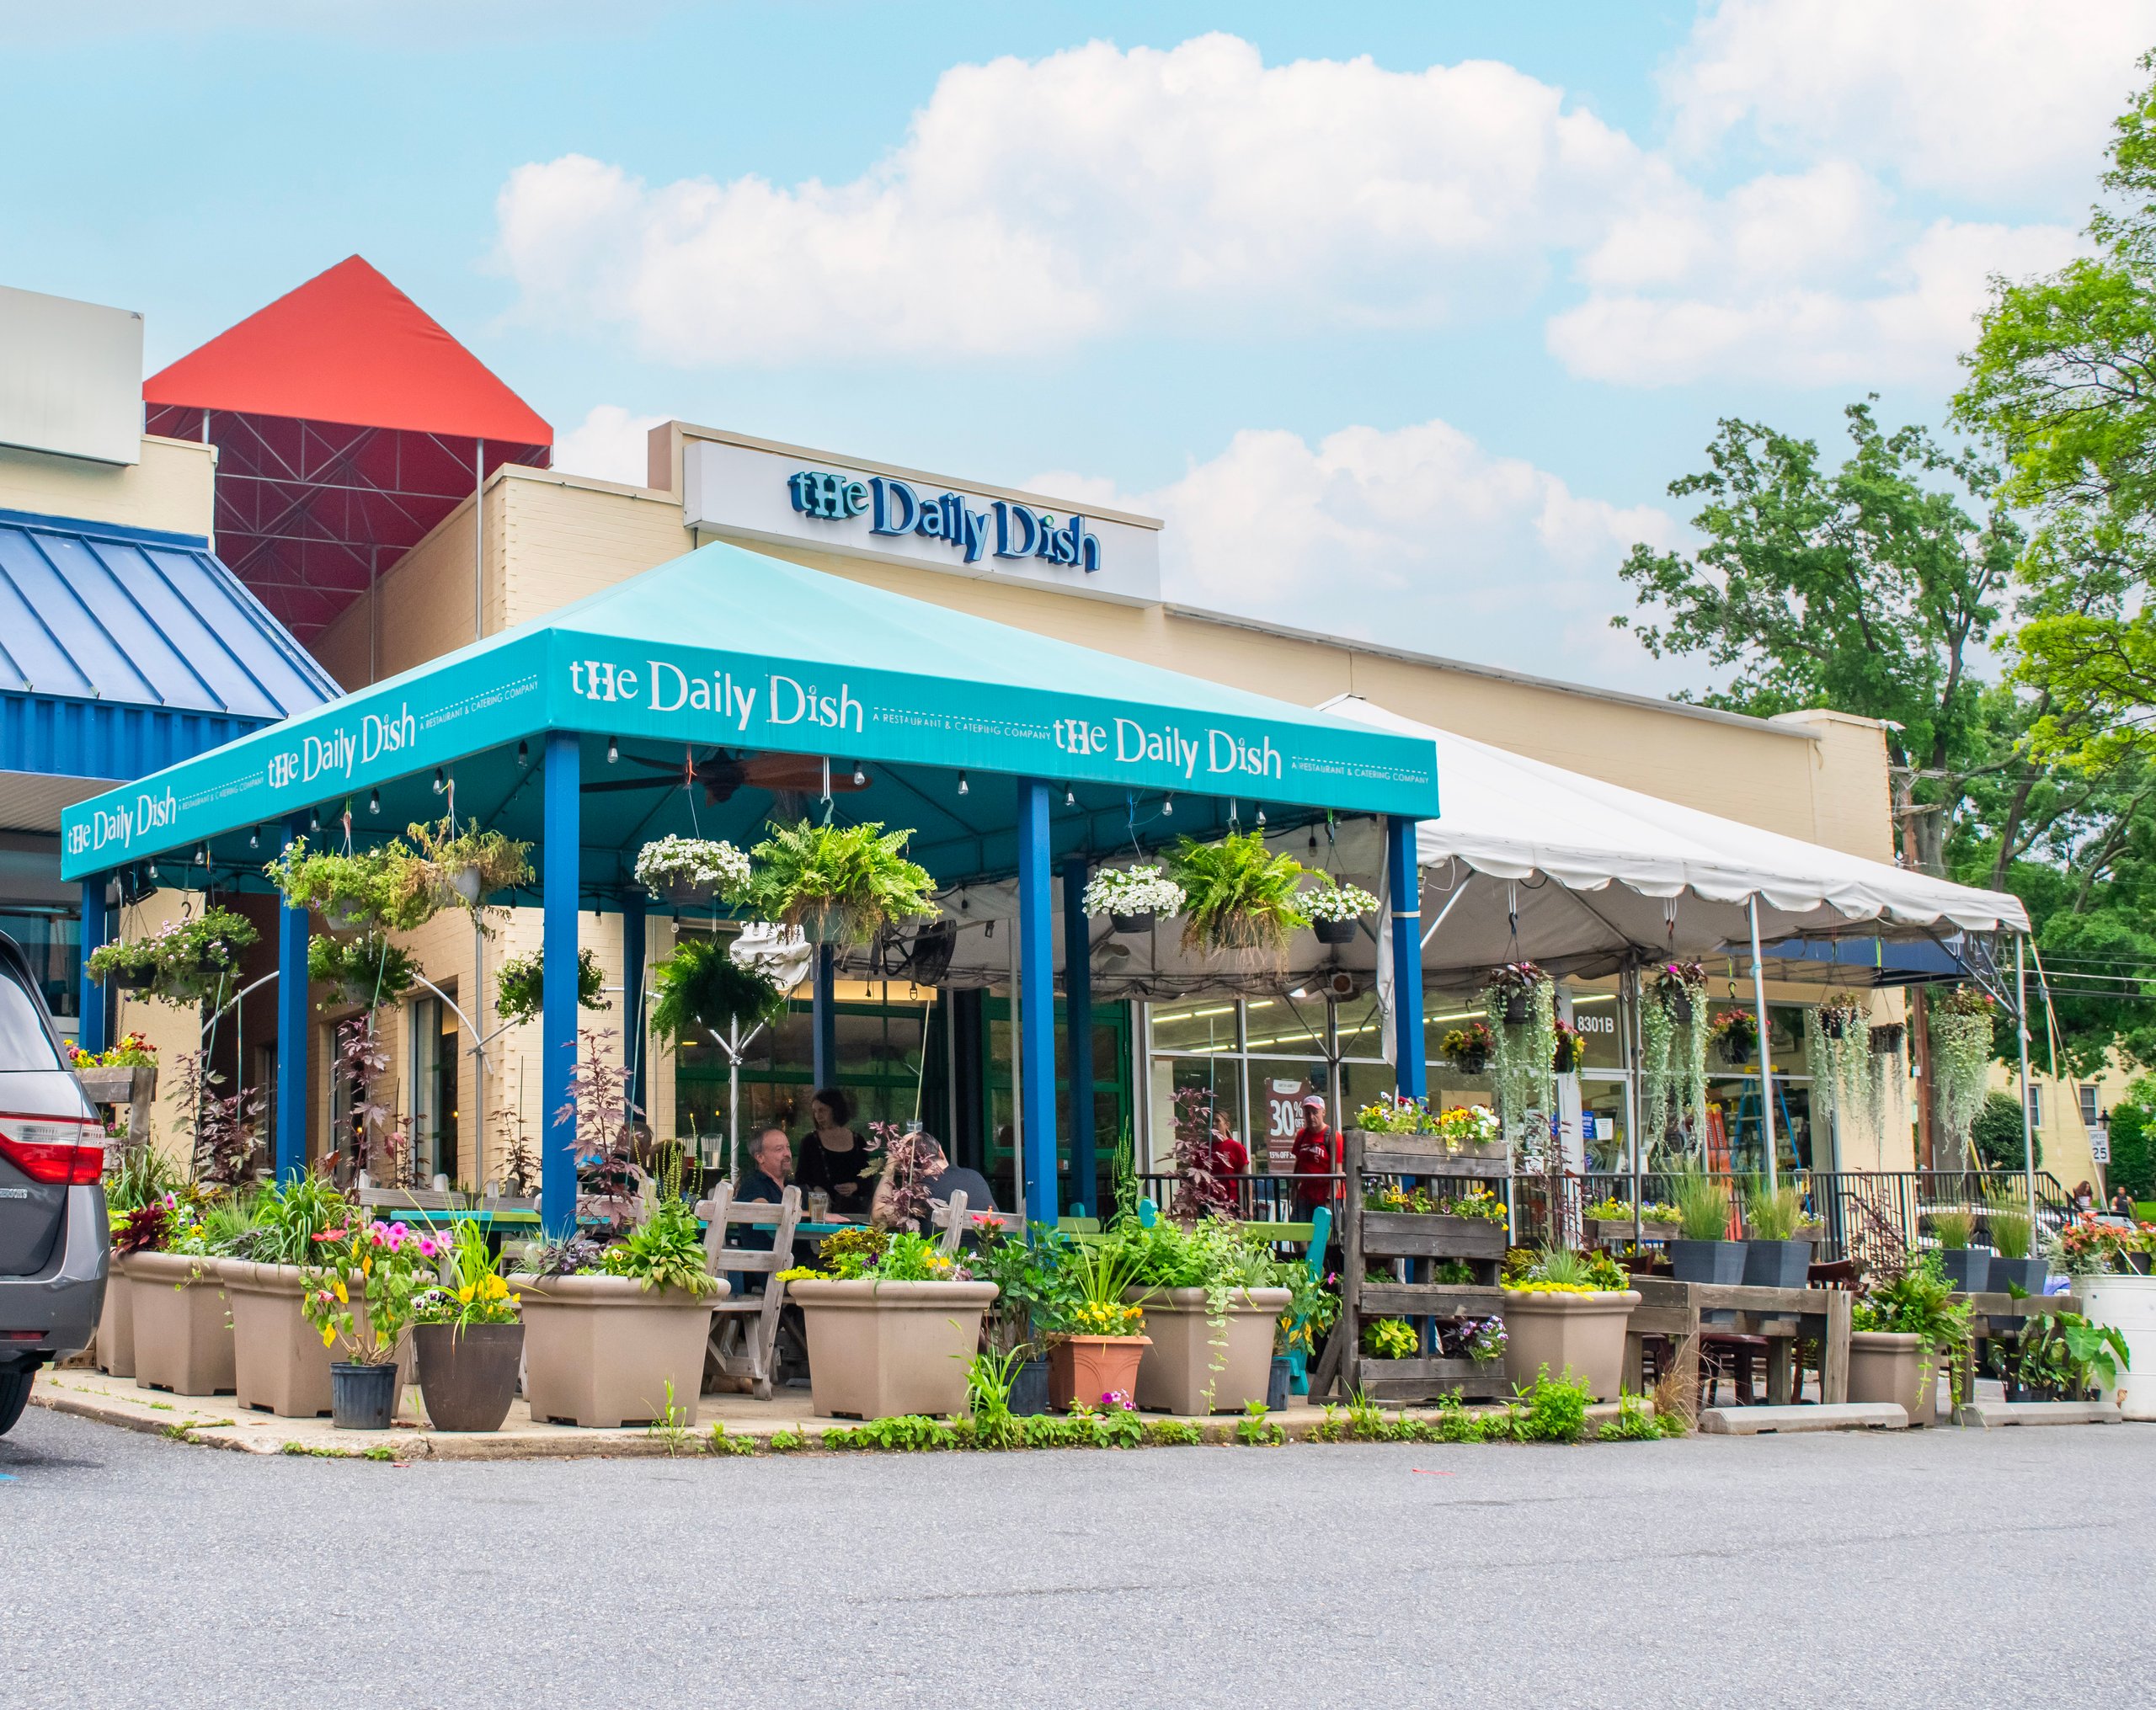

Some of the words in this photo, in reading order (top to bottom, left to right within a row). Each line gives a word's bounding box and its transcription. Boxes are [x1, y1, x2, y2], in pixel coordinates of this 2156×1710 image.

[787, 471, 869, 521] tHe
[868, 477, 991, 563] Daily
[991, 501, 1101, 573] Dish
[419, 722, 424, 731] A
[425, 706, 462, 729] RESTAURANT
[471, 693, 503, 712] CATERING
[504, 680, 538, 701] COMPANY
[569, 660, 638, 702] tHe
[647, 659, 756, 731] Daily
[765, 673, 863, 732] Dish
[268, 752, 299, 789] tHe
[302, 727, 356, 783] Daily
[360, 701, 415, 764] Dish
[873, 713, 880, 722] A
[883, 714, 942, 728] RESTAURANT
[944, 721, 952, 730] &
[954, 722, 1001, 735] CATERING
[1004, 727, 1051, 741] COMPANY
[1053, 718, 1107, 756] tHe
[1113, 717, 1199, 780] Daily
[1204, 728, 1282, 780] Dish
[1291, 761, 1298, 770] A
[1299, 762, 1345, 775] RESTAURANT
[1354, 768, 1391, 780] CATERING
[1393, 772, 1429, 784] COMPANY
[67, 824, 91, 855] tHe
[93, 804, 133, 850] Daily
[136, 786, 176, 836] Dish
[1577, 1015, 1614, 1033] 8301B
[1294, 1118, 1305, 1128] OFF
[2092, 1148, 2107, 1159] 25
